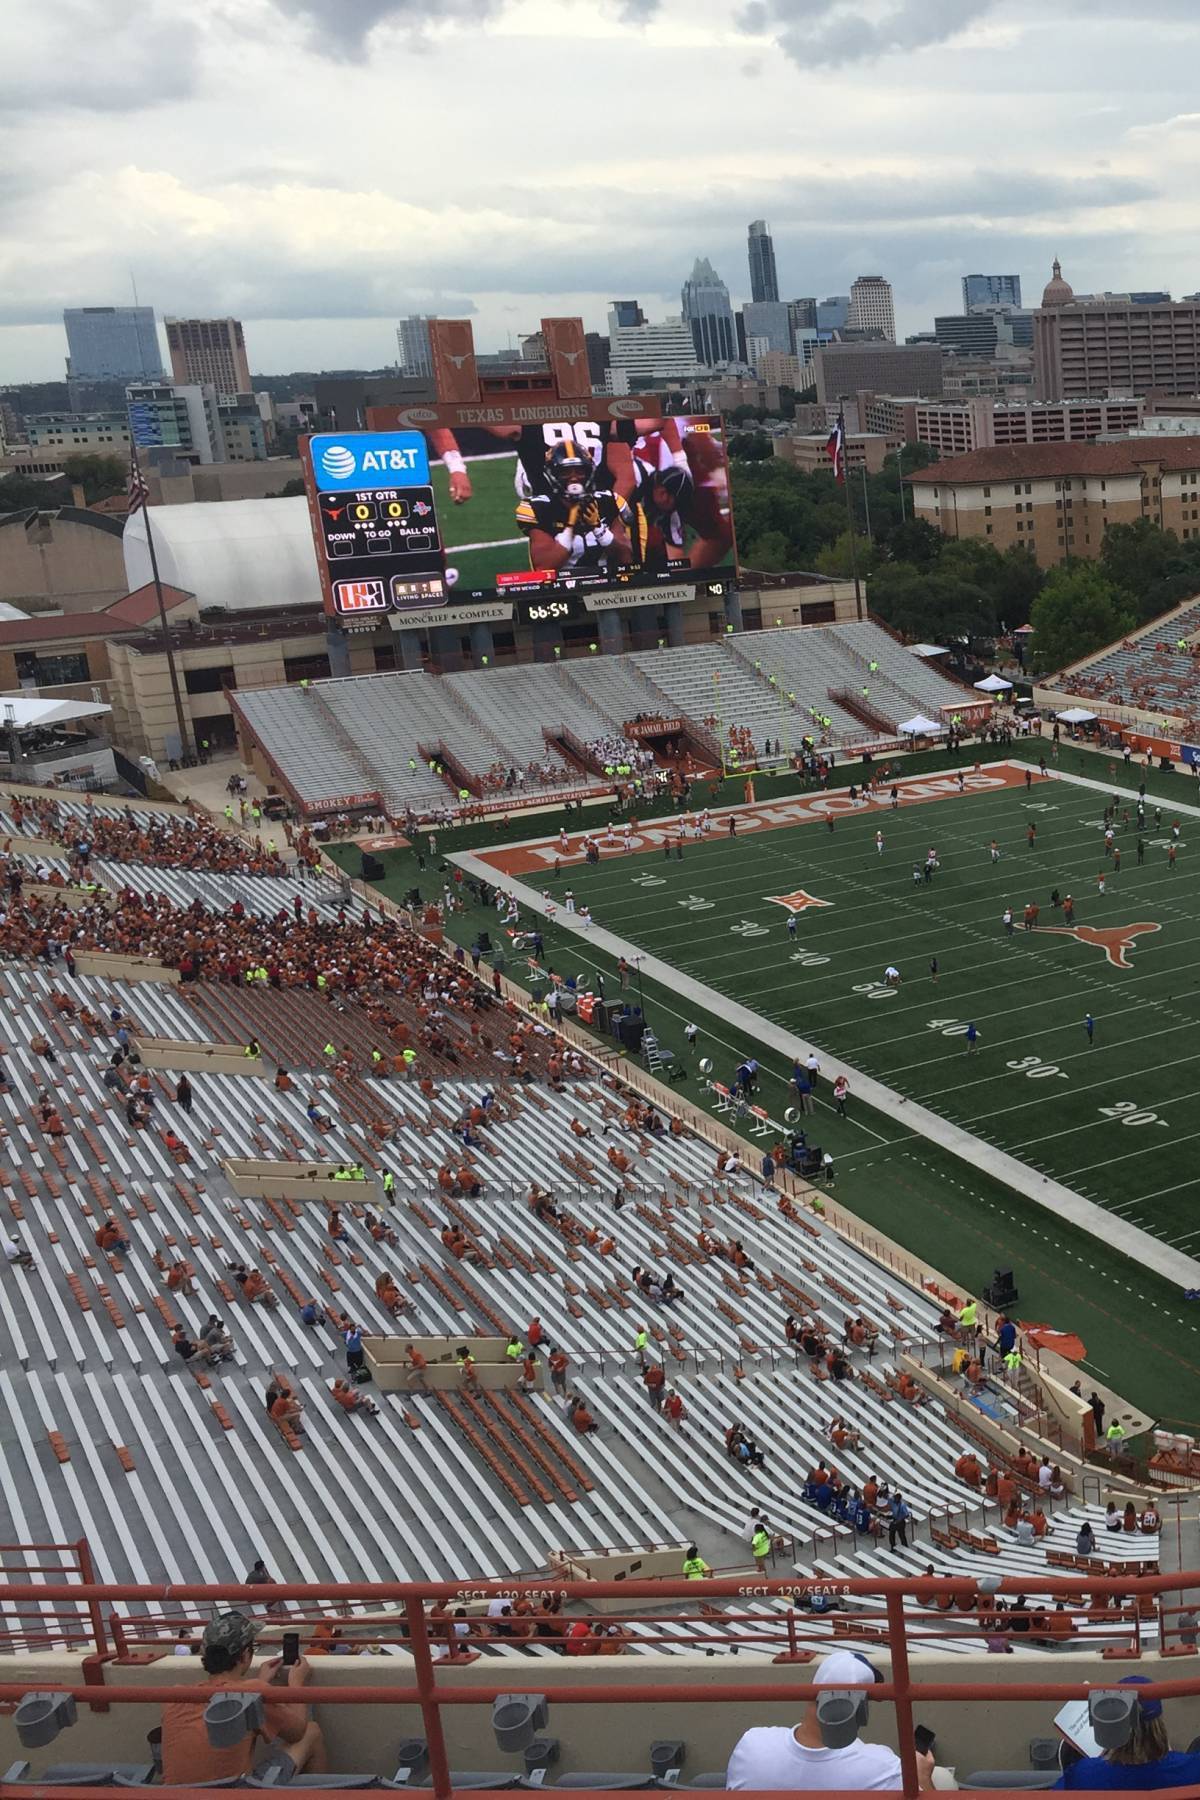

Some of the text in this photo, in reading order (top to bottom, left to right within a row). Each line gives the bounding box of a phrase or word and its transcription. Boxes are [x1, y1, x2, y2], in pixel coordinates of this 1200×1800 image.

[456, 404, 589, 423] TEXAS LONGHORNS
[362, 448, 418, 472] AT&T
[355, 490, 398, 502] 1ST QTR
[356, 504, 369, 519] 0
[388, 502, 401, 517] 0
[328, 532, 356, 541] DOWN
[364, 529, 392, 538] TO GO
[400, 526, 435, 536] BALL ON
[708, 583, 723, 595] 40
[593, 590, 688, 607] MONCRIEF COMPLEX
[399, 608, 505, 626] MONCRIEF COMPLEX
[528, 602, 569, 620] 66:54
[307, 797, 351, 811] SMOKEY
[528, 774, 1008, 864] LONGHORNS
[631, 871, 667, 888] 10
[678, 893, 716, 911] 20
[729, 919, 770, 937] 30
[789, 947, 832, 967] 40
[851, 980, 899, 999] 50
[925, 1016, 971, 1037] 40
[1005, 1055, 1060, 1079] 30
[1096, 1100, 1159, 1127] 20
[842, 1585, 850, 1596] 8
